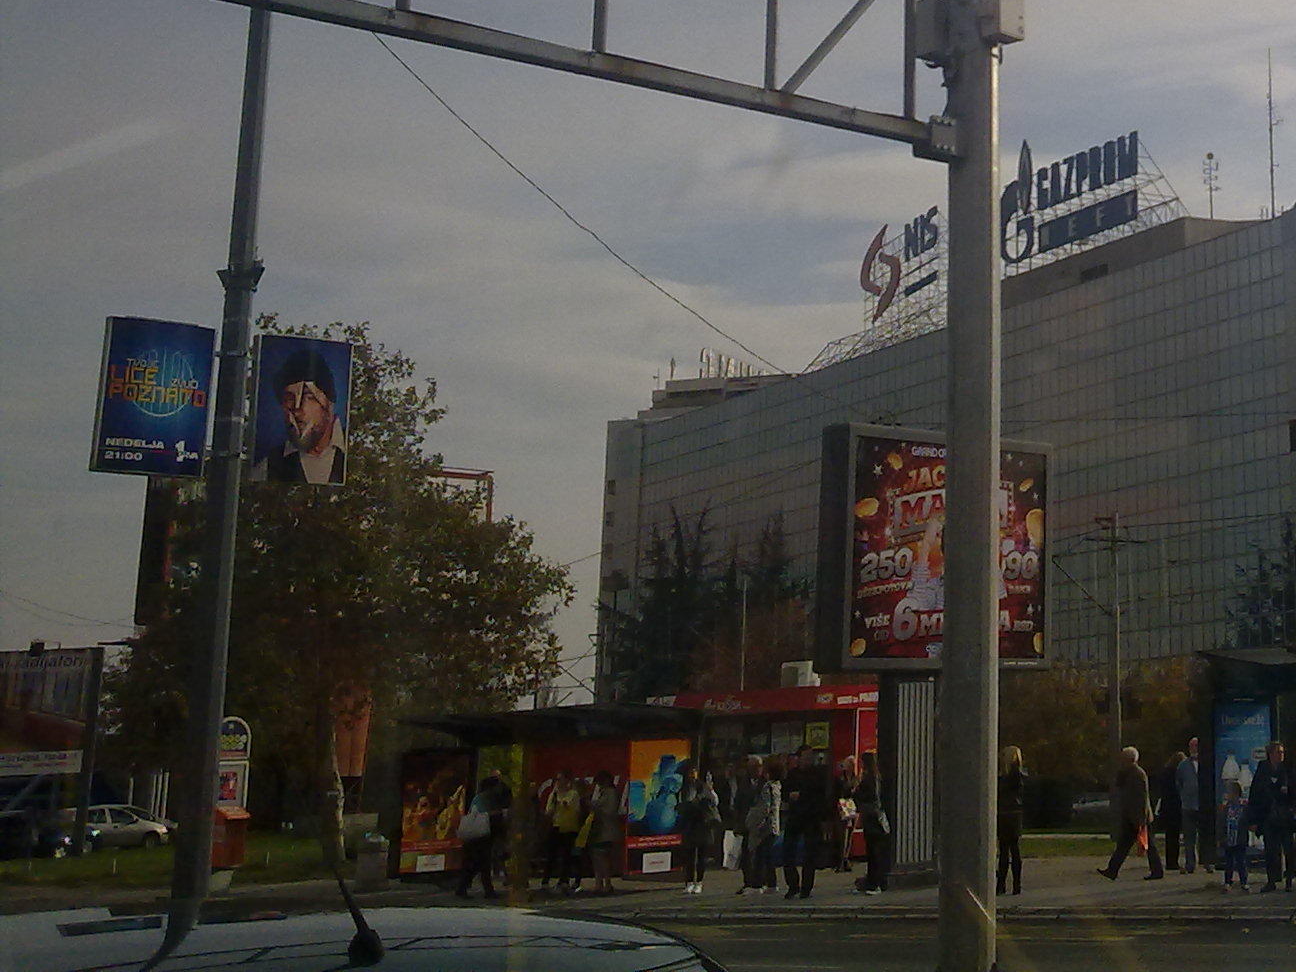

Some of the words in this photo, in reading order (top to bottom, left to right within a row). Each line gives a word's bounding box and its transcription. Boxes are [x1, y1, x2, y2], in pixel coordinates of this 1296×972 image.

[1037, 131, 1138, 210] GAZPROM
[904, 206, 938, 261] NIS
[109, 364, 159, 385] LICE
[107, 383, 207, 408] POZNATO
[103, 451, 143, 461] 21:00
[104, 437, 165, 450] NEDELJA
[860, 547, 914, 582] 250
[892, 597, 919, 641] 6
